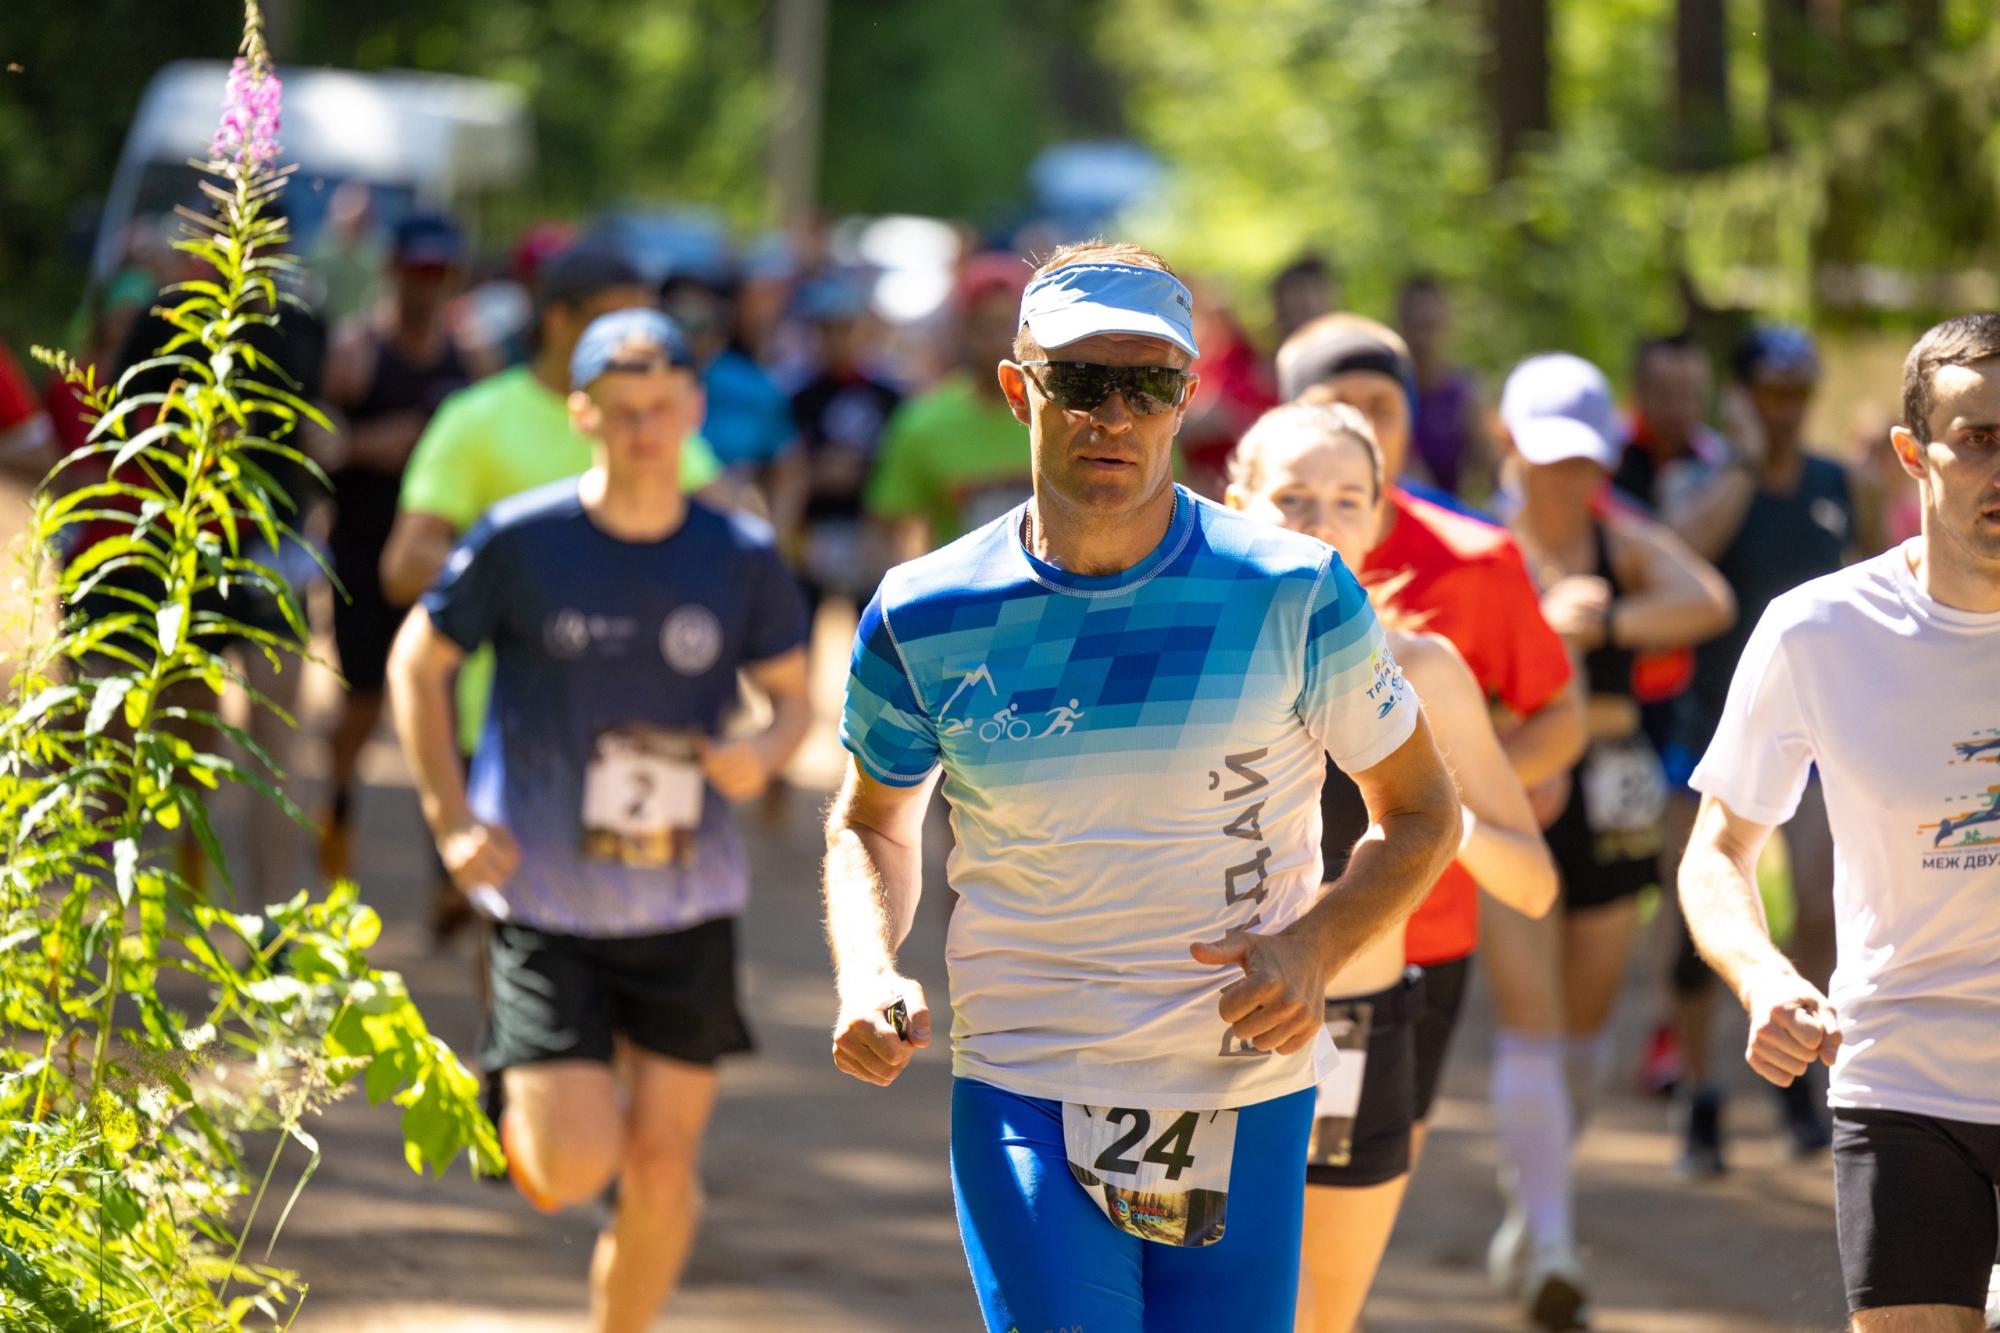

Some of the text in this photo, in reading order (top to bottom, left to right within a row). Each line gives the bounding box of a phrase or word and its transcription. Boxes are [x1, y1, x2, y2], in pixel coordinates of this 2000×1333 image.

[622, 770, 656, 820] 2
[1922, 853, 2000, 871] МЕЖ ДВУ
[1094, 1107, 1200, 1181] 24
